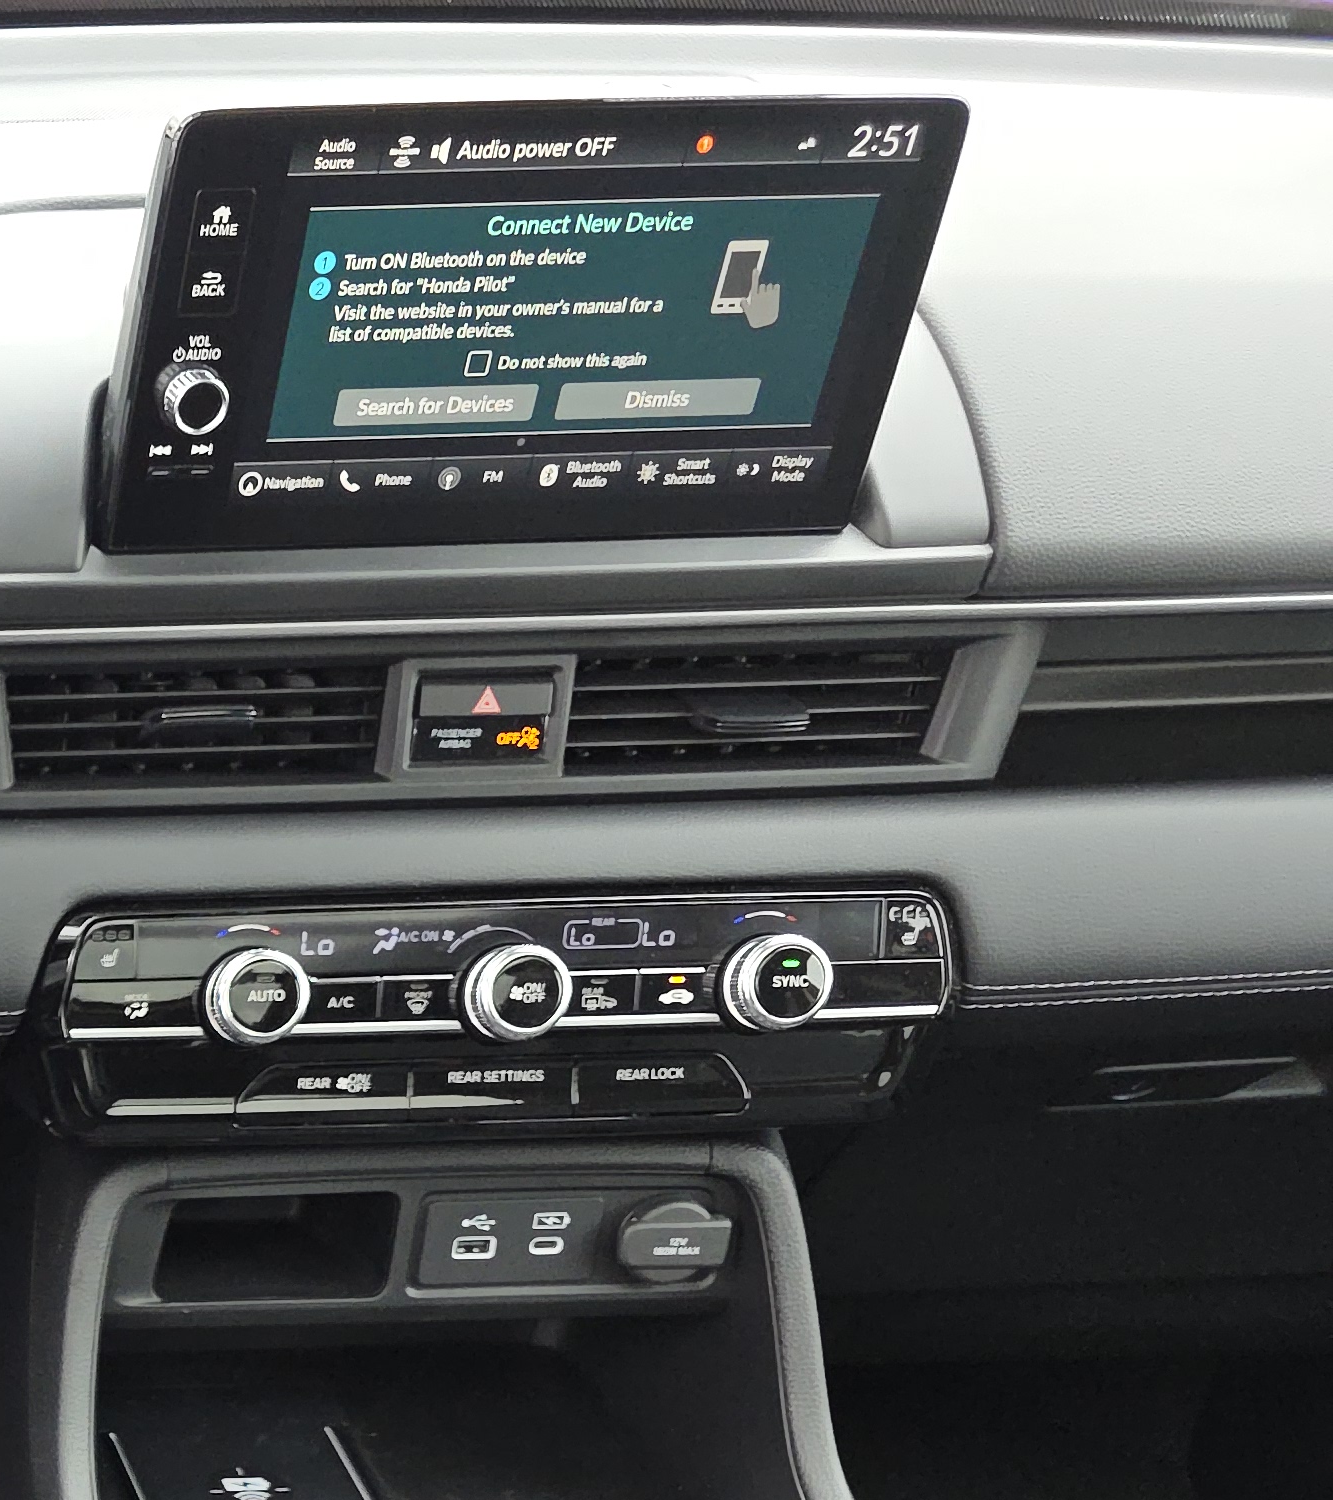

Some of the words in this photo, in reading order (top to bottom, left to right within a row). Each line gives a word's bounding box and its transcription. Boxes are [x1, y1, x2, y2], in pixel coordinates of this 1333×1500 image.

[319, 139, 356, 153] Audio
[847, 124, 919, 157] 2:51
[457, 140, 510, 159] Audio
[513, 142, 572, 162] power
[575, 137, 616, 156] OFF
[314, 157, 354, 170] Source
[199, 223, 239, 237] HOME
[487, 214, 571, 236] Connect
[574, 213, 622, 234] New
[626, 211, 693, 232] Device
[344, 254, 377, 270] Turn
[381, 253, 406, 269] ON
[411, 251, 483, 269] Bluetooth
[487, 255, 506, 267] on
[510, 251, 534, 266] the
[537, 249, 586, 265] device
[191, 284, 226, 298] BACK
[338, 279, 388, 296] Search
[391, 279, 413, 295] for
[417, 277, 470, 294] "Honda
[474, 276, 515, 292] Pilot"
[334, 305, 366, 322] Visit
[370, 304, 395, 320] the
[397, 303, 455, 319] website
[458, 301, 472, 318] in
[475, 304, 510, 322] your
[512, 300, 570, 317] owner's
[573, 298, 626, 315] manual
[629, 297, 652, 313] for
[653, 301, 664, 313] a
[328, 326, 351, 342] list
[354, 325, 370, 341] of
[373, 322, 454, 343] compatible
[457, 321, 515, 339] devices.
[188, 335, 212, 348] VOL
[186, 347, 222, 361] AUDIO
[498, 355, 519, 370] Do
[521, 355, 544, 369] not
[547, 354, 584, 368] show
[586, 352, 610, 368] this
[611, 352, 647, 369] again
[357, 398, 412, 417] Search
[418, 396, 442, 414] for
[446, 395, 514, 414] Devices
[624, 390, 690, 409] Dismiss
[565, 460, 622, 474] Bluetooth
[677, 457, 711, 471] Smart
[772, 454, 814, 470] Display
[374, 473, 412, 487] Phone
[482, 470, 504, 484] FM
[572, 475, 608, 488] Audio
[662, 472, 716, 486] Shortcuts
[771, 469, 806, 483] Mode
[264, 476, 324, 492] Navigation
[398, 930, 420, 942] A/C
[421, 930, 440, 942] ON
[772, 974, 810, 989] SYNC
[247, 988, 286, 1002] AUTO
[326, 996, 355, 1009] A/C
[447, 1070, 482, 1084] REAR
[483, 1069, 545, 1083] SETTINGS
[616, 1068, 650, 1081] REAR
[650, 1065, 684, 1080] LOCK
[297, 1077, 331, 1090] REAR
